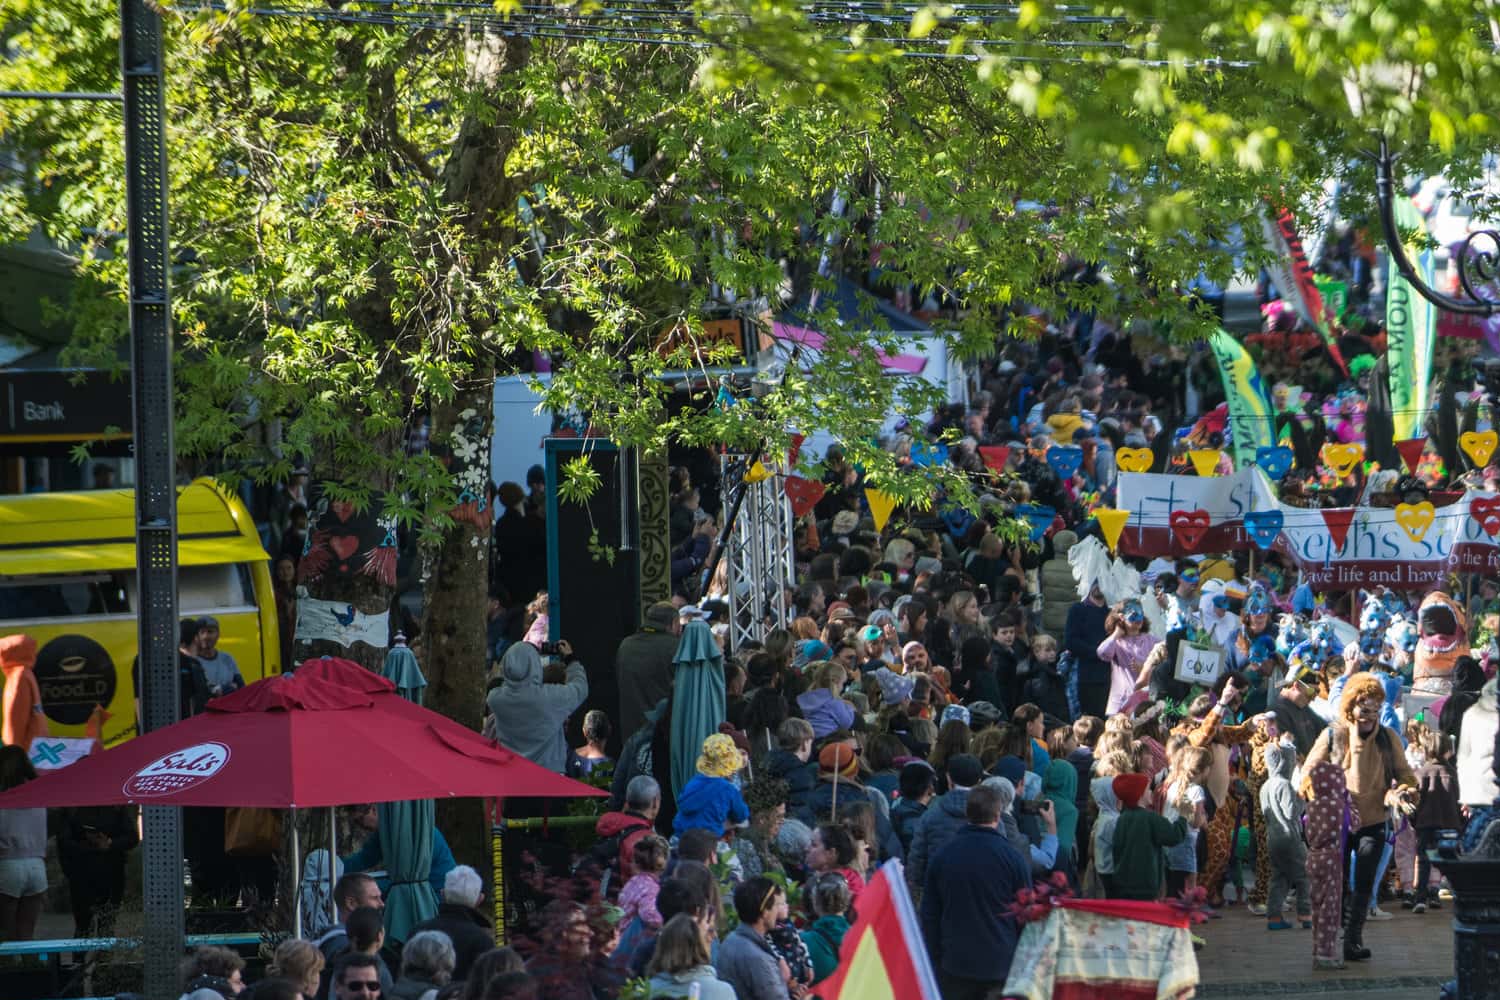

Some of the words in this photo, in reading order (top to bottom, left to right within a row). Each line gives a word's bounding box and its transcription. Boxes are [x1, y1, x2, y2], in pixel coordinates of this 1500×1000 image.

[23, 400, 65, 421] Bank
[1338, 564, 1364, 583] life
[1368, 565, 1401, 583] and
[1407, 564, 1446, 583] have
[1463, 546, 1482, 566] the
